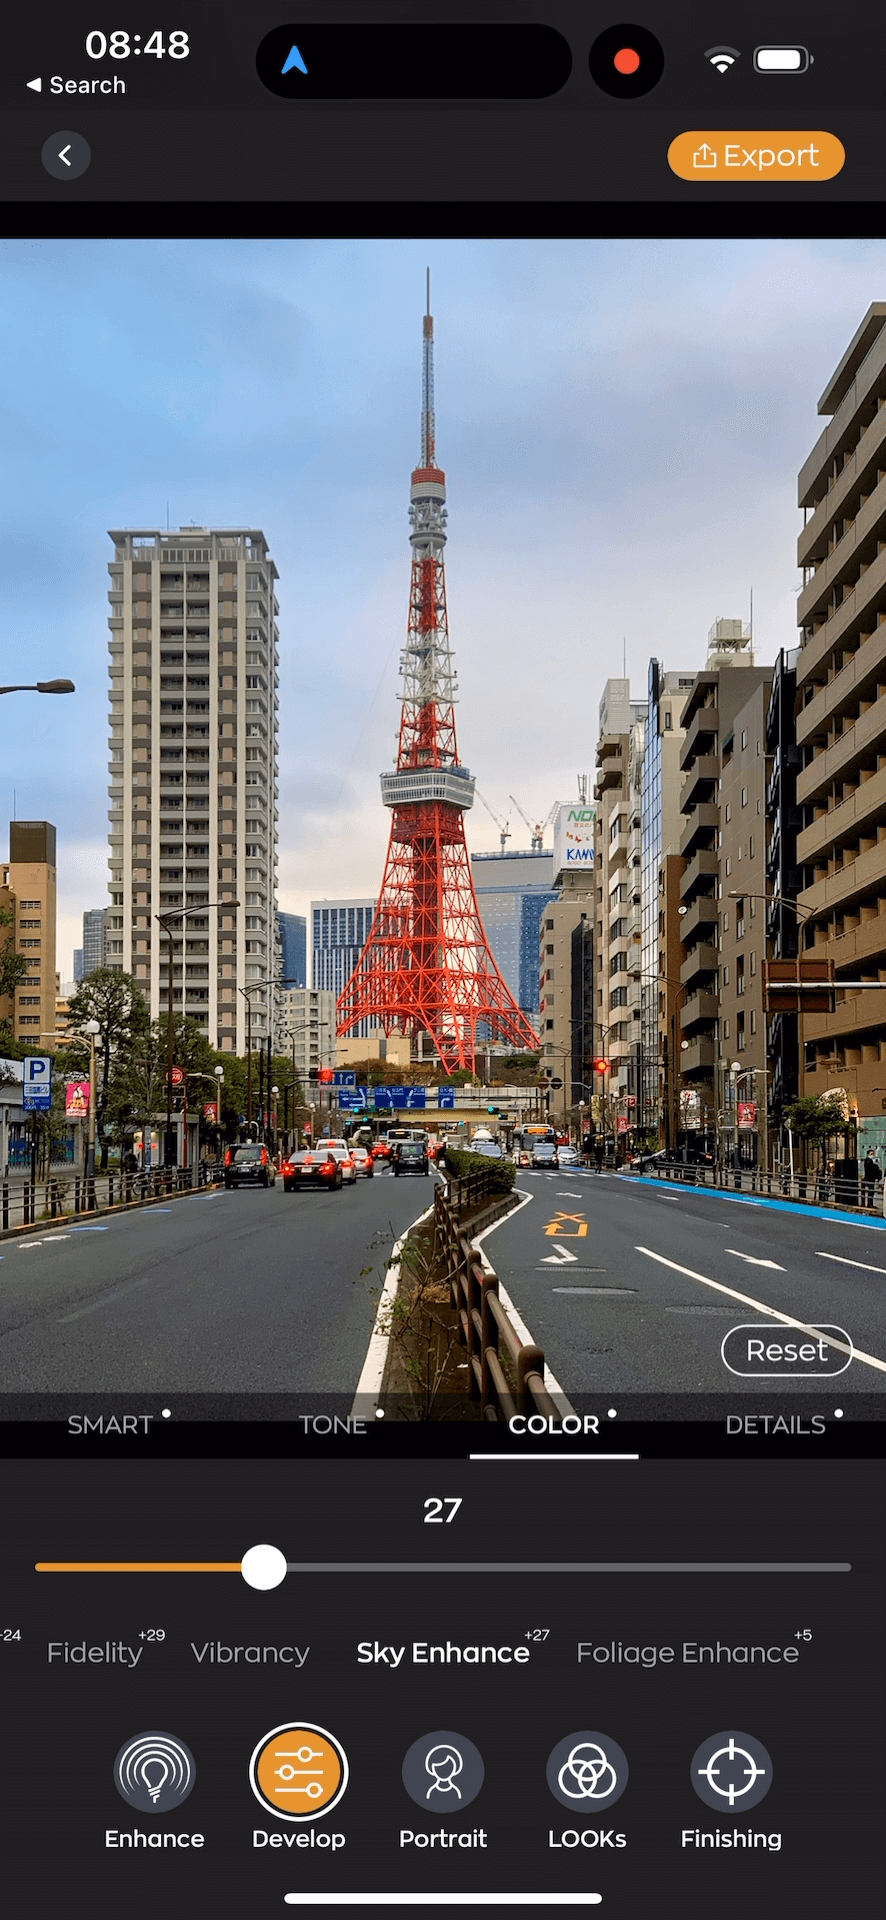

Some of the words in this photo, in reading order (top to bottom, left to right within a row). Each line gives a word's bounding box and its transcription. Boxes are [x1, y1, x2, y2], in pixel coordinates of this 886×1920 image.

[86, 31, 190, 60] 08:48
[49, 76, 126, 95] Search
[724, 143, 820, 171] Export
[30, 1061, 46, 1080] P
[747, 1338, 829, 1362] Reset
[67, 1415, 153, 1434] SMART
[299, 1415, 367, 1434] TONE
[508, 1415, 600, 1435] COLOR
[726, 1415, 826, 1434] DETAILS
[423, 1497, 463, 1523] 27
[139, 1629, 166, 1642] +29
[525, 1629, 550, 1642] +27
[795, 1629, 812, 1642] +5
[48, 1642, 143, 1667] Fidelity
[191, 1642, 310, 1668] Vibrancy
[357, 1641, 405, 1668] Sky
[412, 1641, 531, 1664] Enhance
[577, 1641, 675, 1668] Foliage
[682, 1642, 799, 1663] Enhance
[105, 1828, 205, 1848] Enhance
[252, 1828, 346, 1852] Develop
[399, 1828, 488, 1848] Portrait
[548, 1829, 627, 1848] LOOKs
[681, 1828, 782, 1852] Finishing
